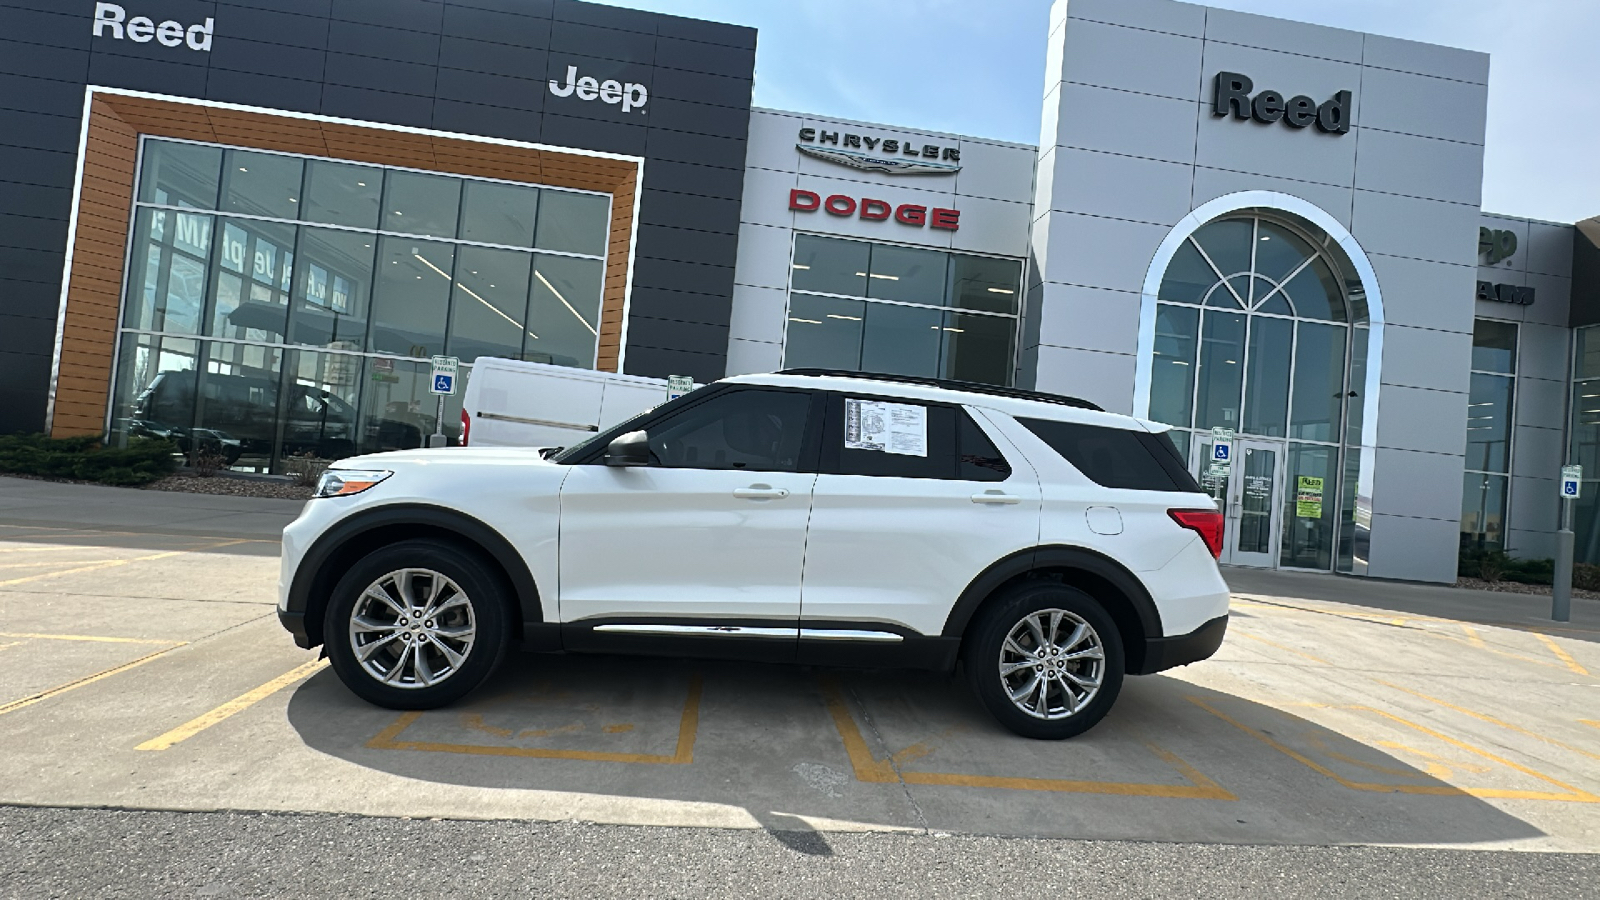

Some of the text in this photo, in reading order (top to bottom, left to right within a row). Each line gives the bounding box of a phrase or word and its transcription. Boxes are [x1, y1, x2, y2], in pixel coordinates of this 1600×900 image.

[93, 2, 215, 52] Reed
[548, 65, 648, 114] Jeep
[1213, 71, 1353, 136] Reed
[799, 127, 961, 162] CHRYSLER
[788, 188, 961, 231] DODGE
